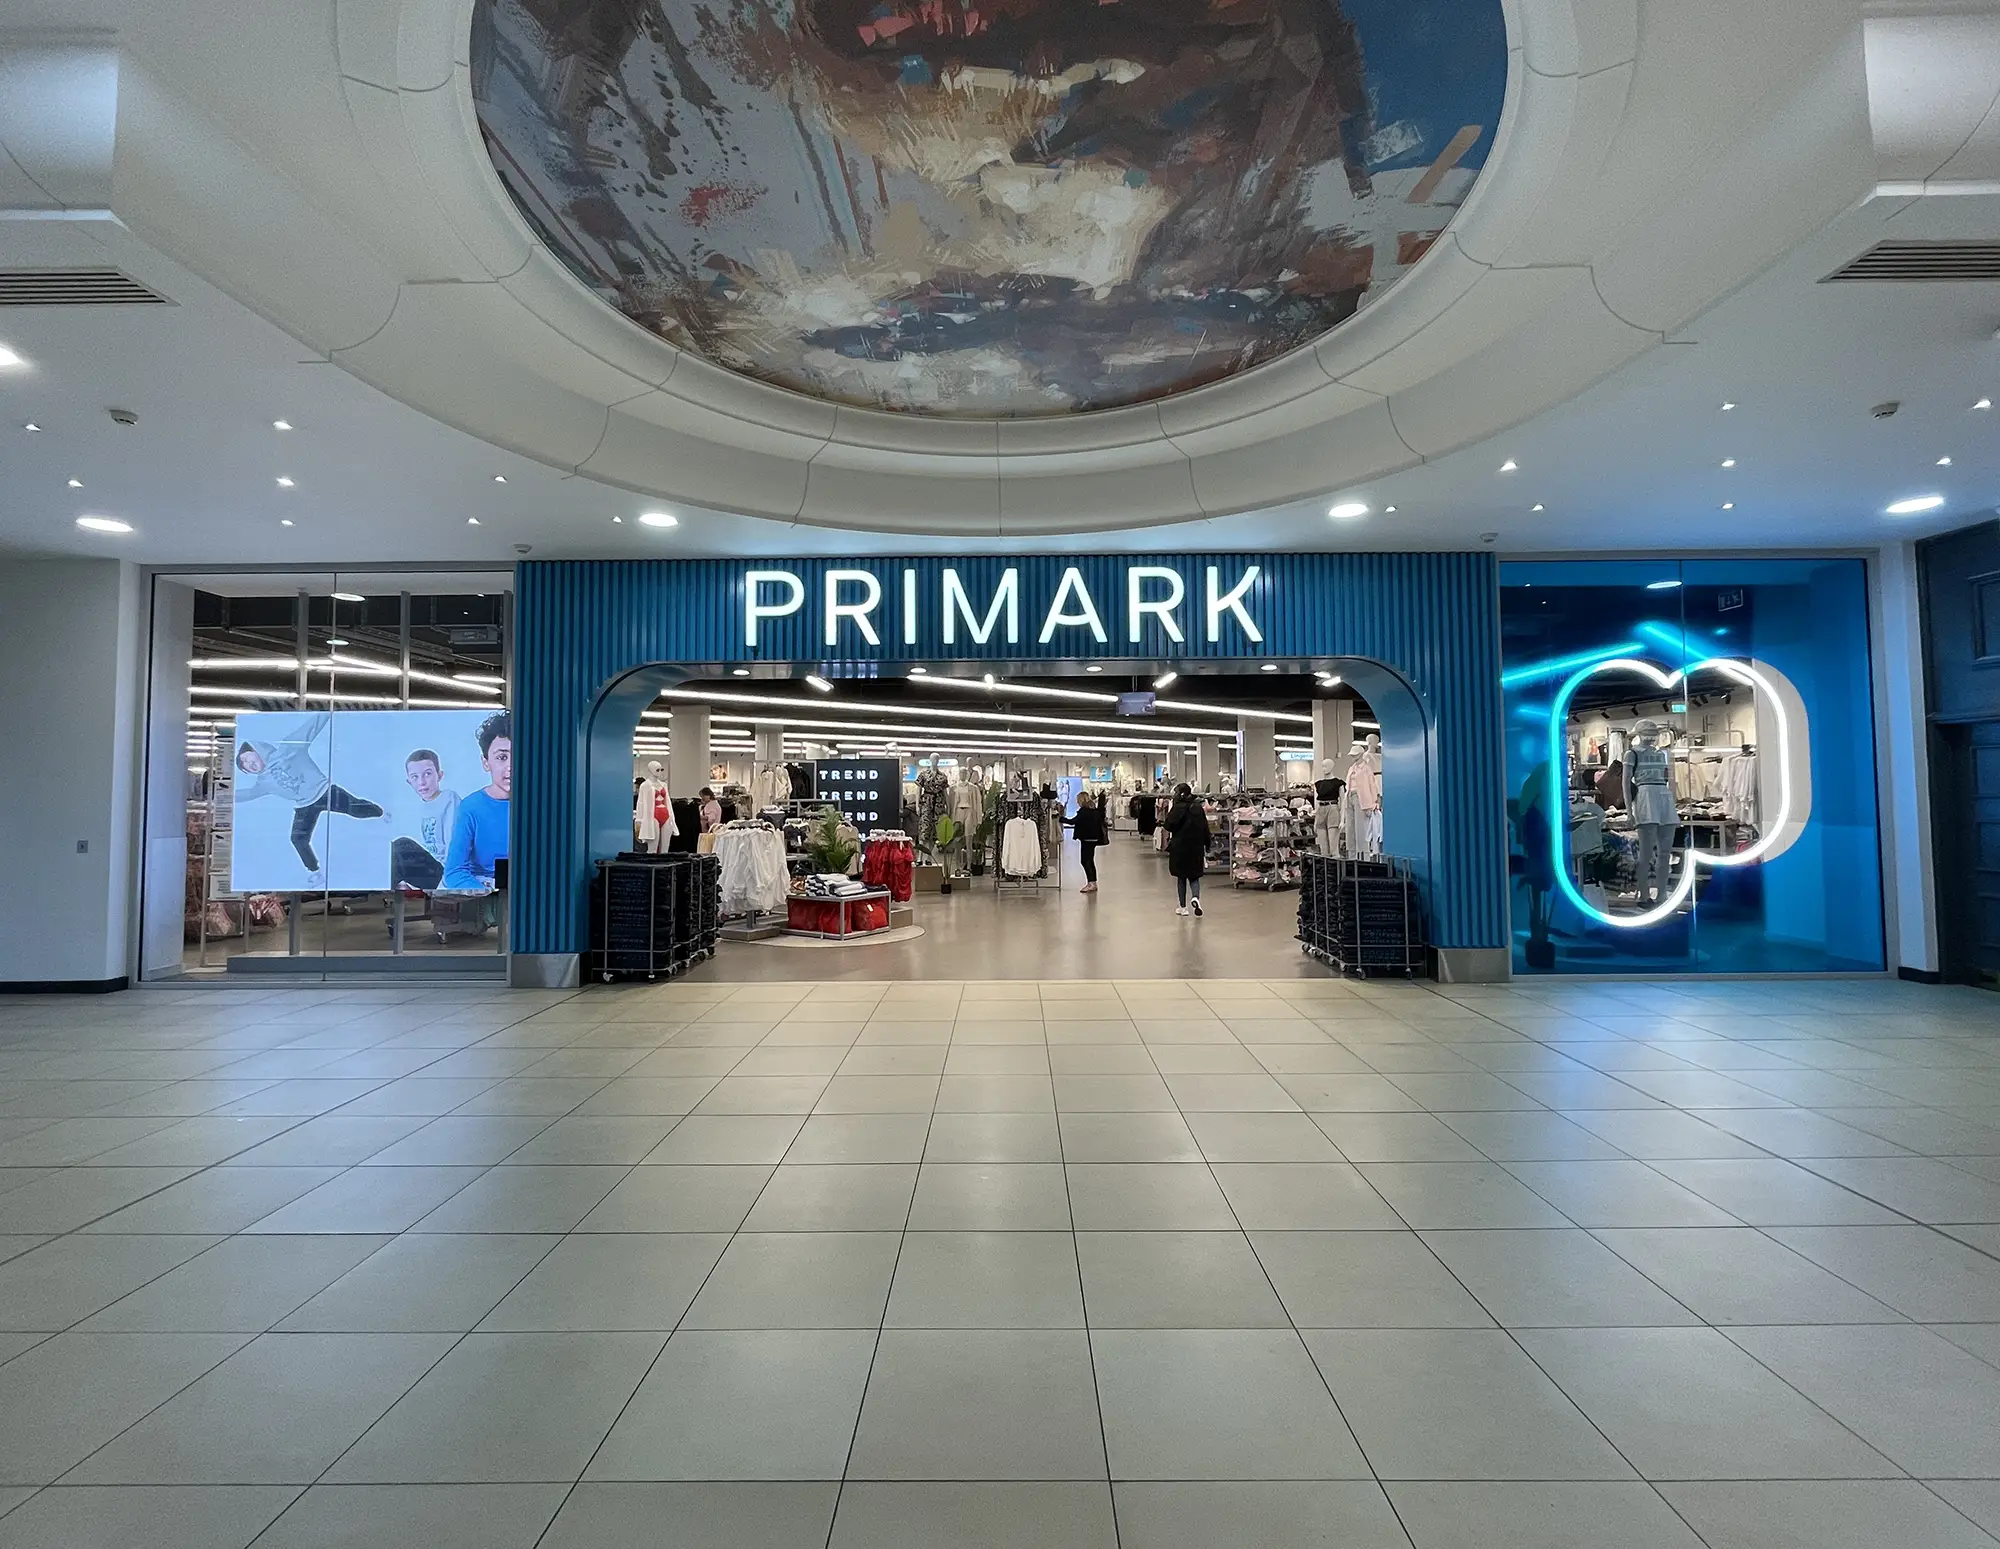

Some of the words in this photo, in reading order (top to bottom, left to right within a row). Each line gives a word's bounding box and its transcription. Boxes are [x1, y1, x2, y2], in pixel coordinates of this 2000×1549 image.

[745, 565, 1264, 646] PRIMARK
[819, 769, 878, 780] TREND
[819, 790, 878, 801] TREND
[844, 811, 878, 822] END
